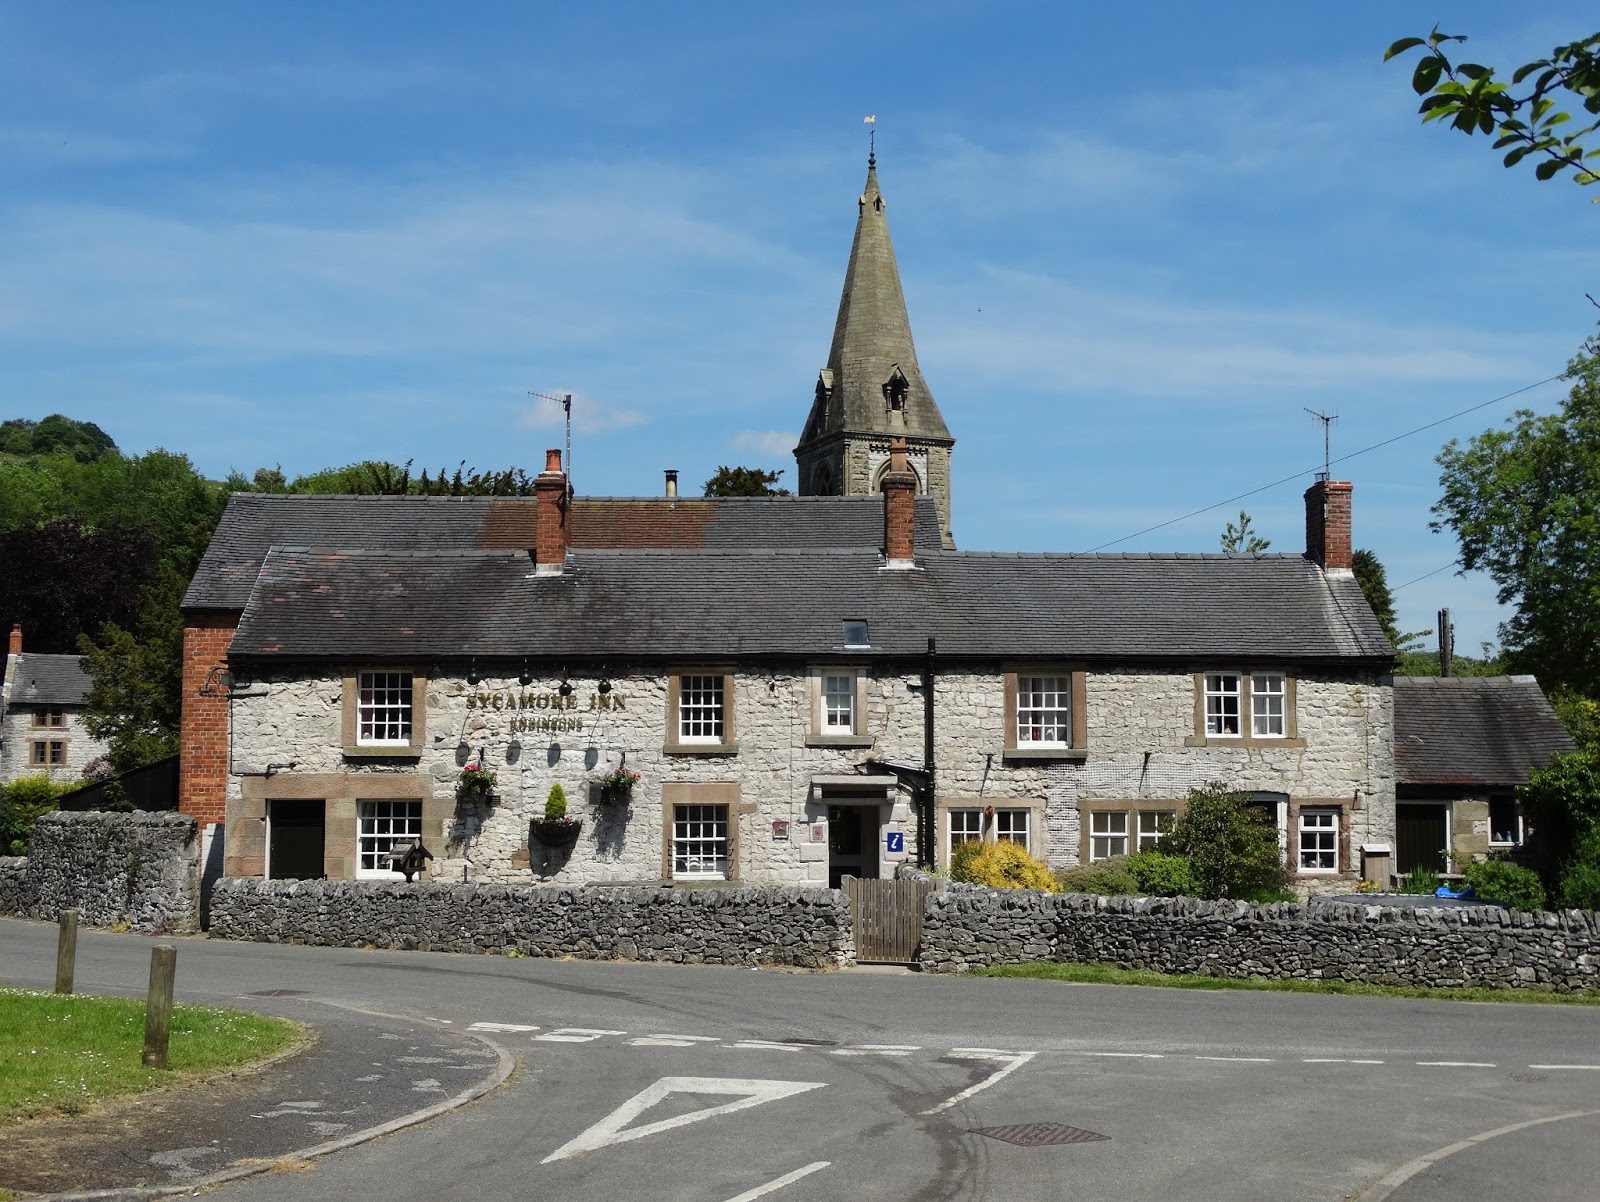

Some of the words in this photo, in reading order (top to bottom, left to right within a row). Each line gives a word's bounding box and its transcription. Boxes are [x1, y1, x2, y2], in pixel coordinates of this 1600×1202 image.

[467, 692, 577, 709] SYCAMORE
[589, 692, 626, 710] INN
[510, 717, 583, 732] ROBINSONS
